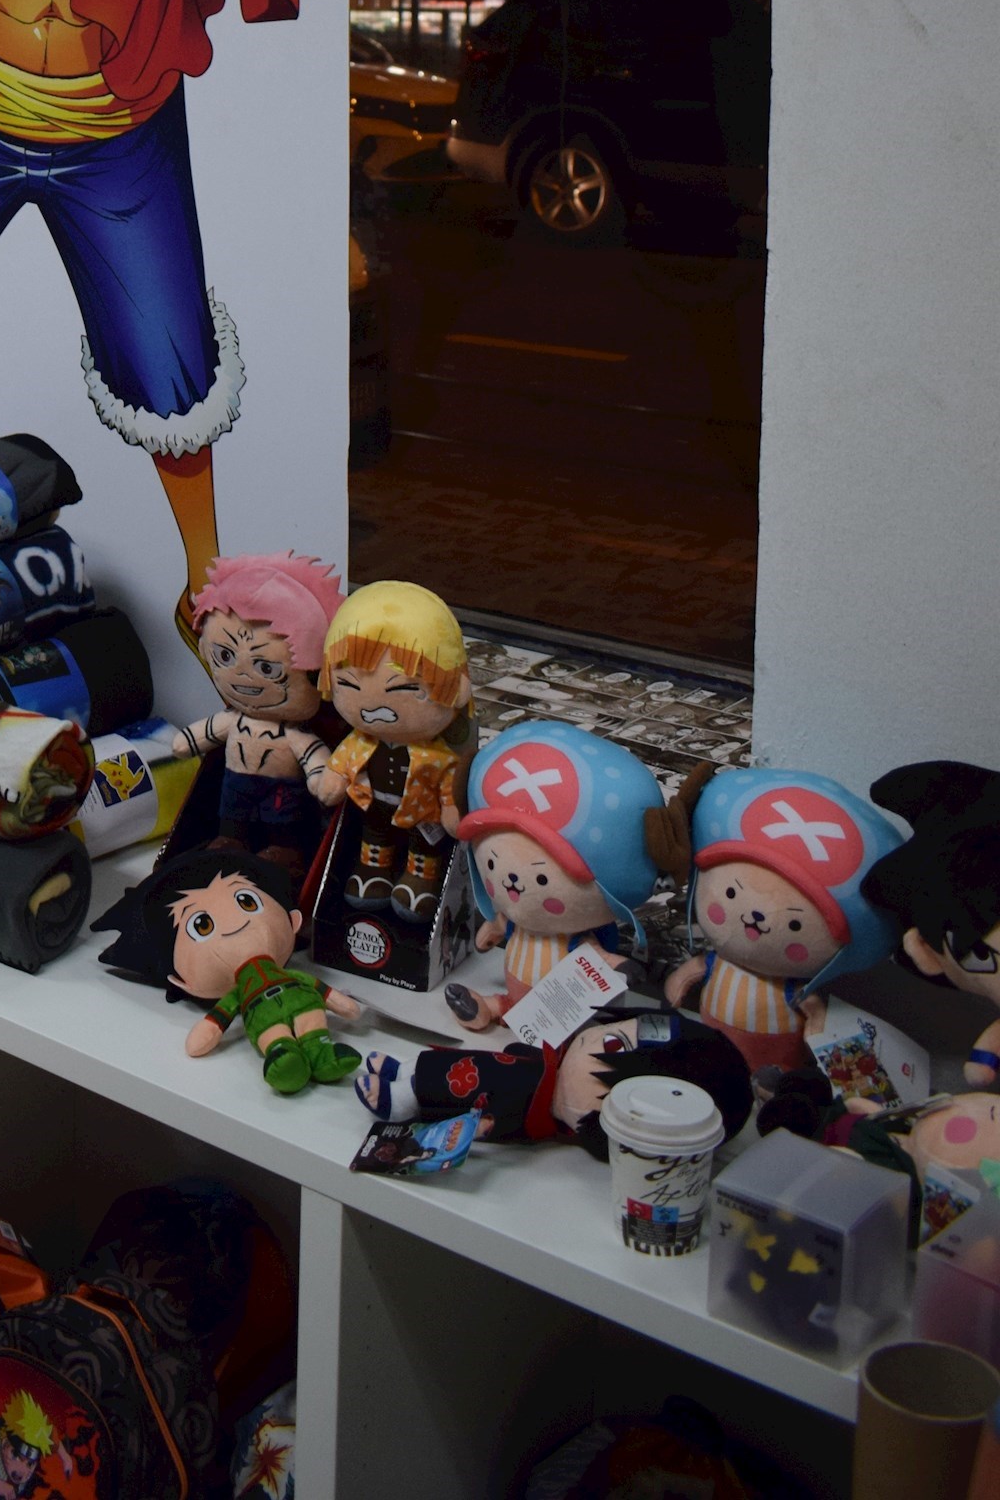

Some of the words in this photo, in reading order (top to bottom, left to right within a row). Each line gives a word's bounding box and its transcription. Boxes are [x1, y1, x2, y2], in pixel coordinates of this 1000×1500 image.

[345, 935, 386, 958] SLAYER
[347, 924, 387, 946] DEMON
[575, 956, 611, 993] SAKAMI
